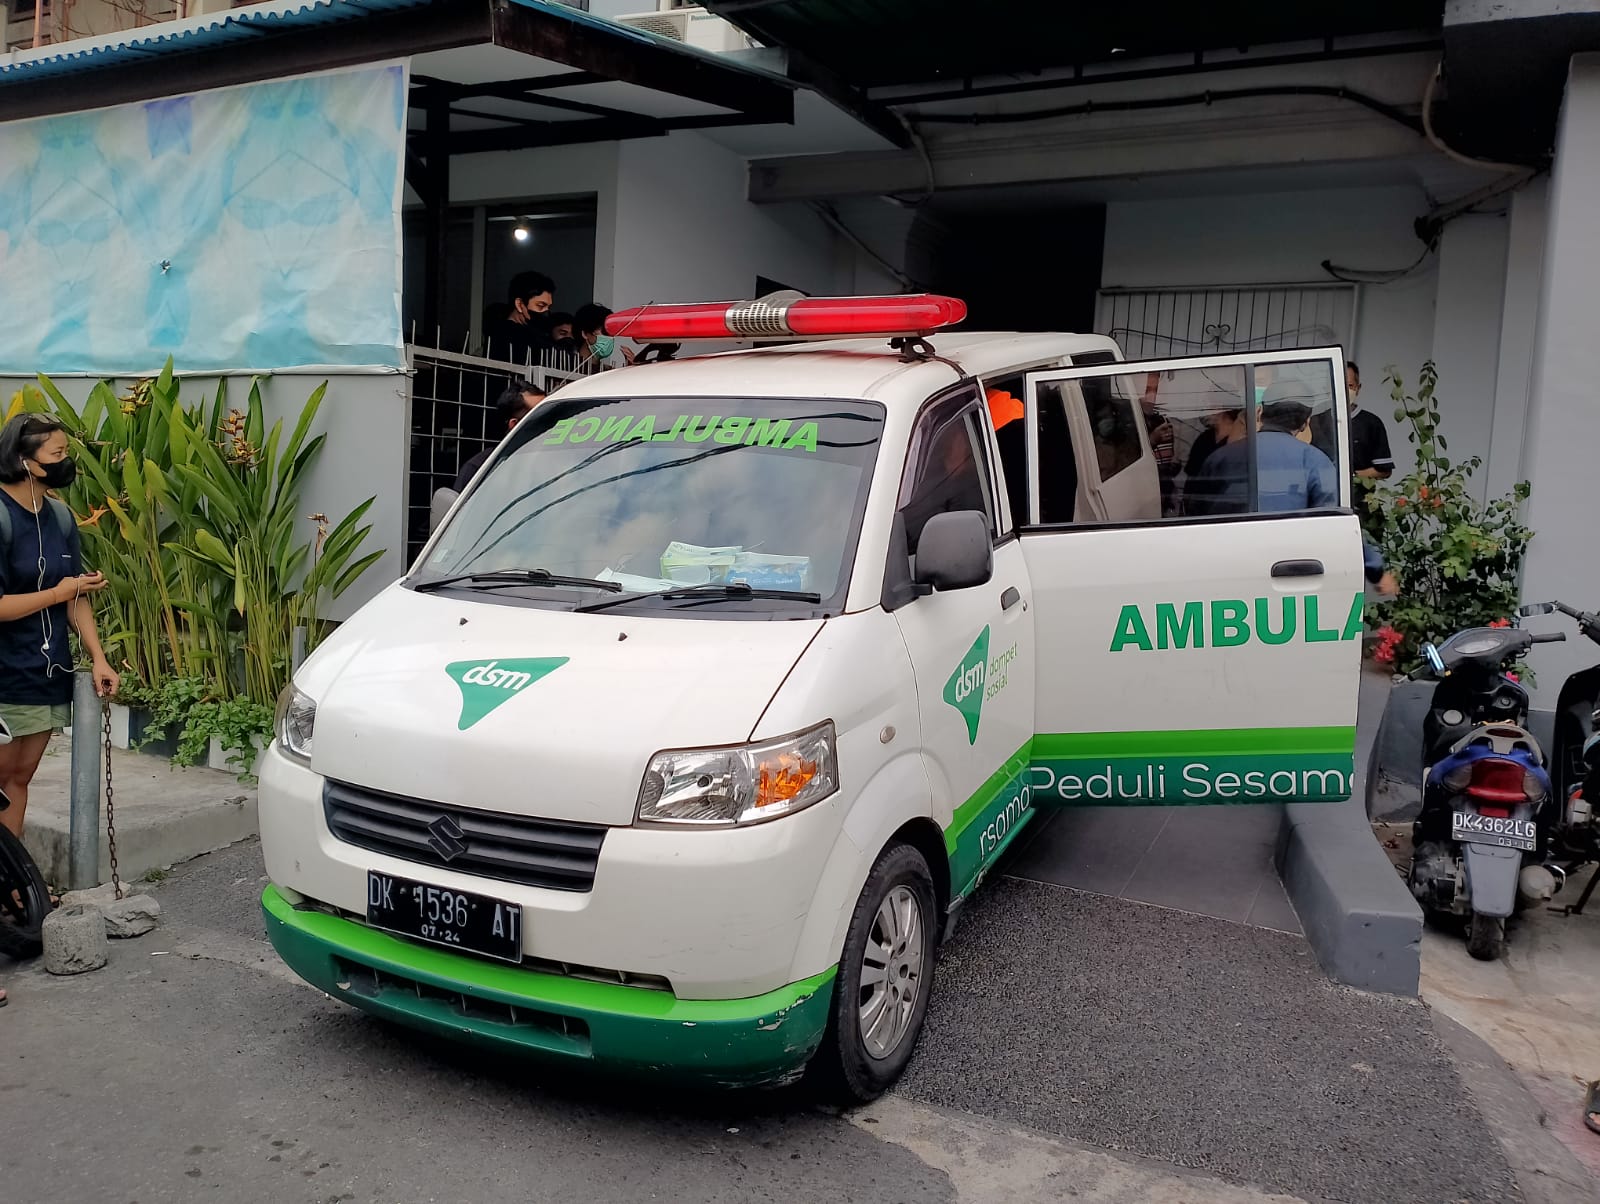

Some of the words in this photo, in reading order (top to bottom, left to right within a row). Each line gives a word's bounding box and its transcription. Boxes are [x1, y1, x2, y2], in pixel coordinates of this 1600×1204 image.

[462, 661, 532, 690] dsm
[989, 641, 1018, 676] dompet
[955, 660, 984, 702] dsm
[986, 672, 1008, 701] sosial
[1181, 763, 1354, 798] Sesam
[369, 874, 394, 911] DK
[413, 885, 468, 927] 1536
[492, 904, 519, 942] AT
